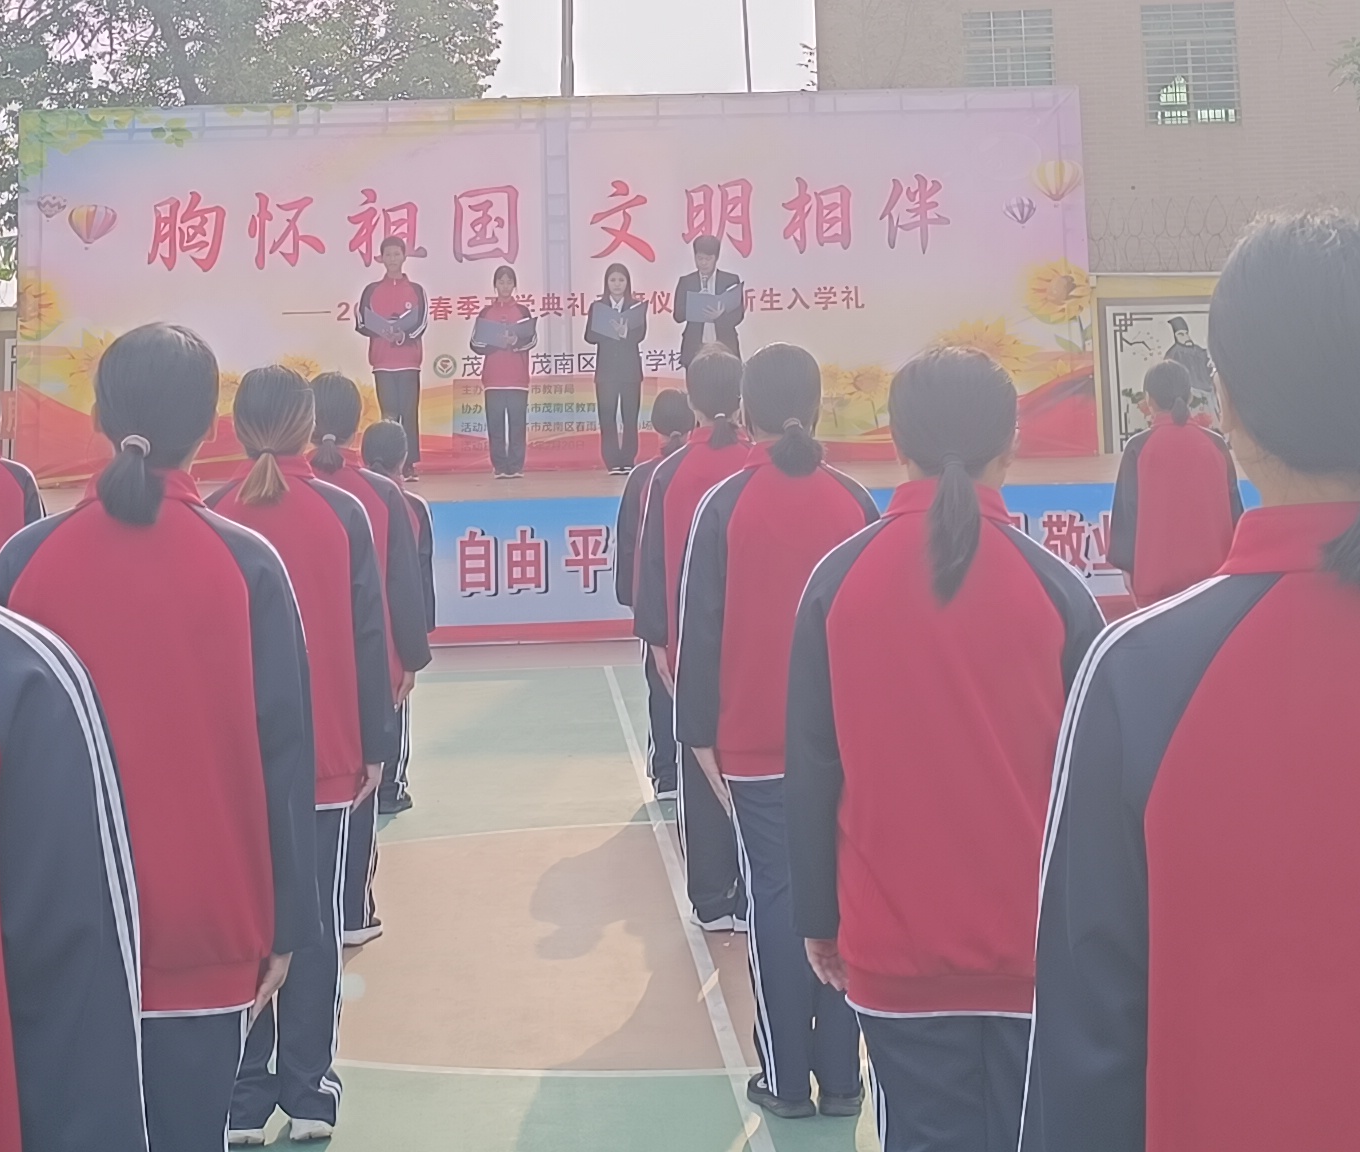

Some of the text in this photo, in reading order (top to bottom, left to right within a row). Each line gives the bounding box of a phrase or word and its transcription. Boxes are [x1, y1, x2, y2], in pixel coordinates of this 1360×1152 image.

[147, 173, 951, 273] 胸怀祖国 文明相伴
[459, 528, 546, 594] 自由
[564, 528, 612, 591] 平
